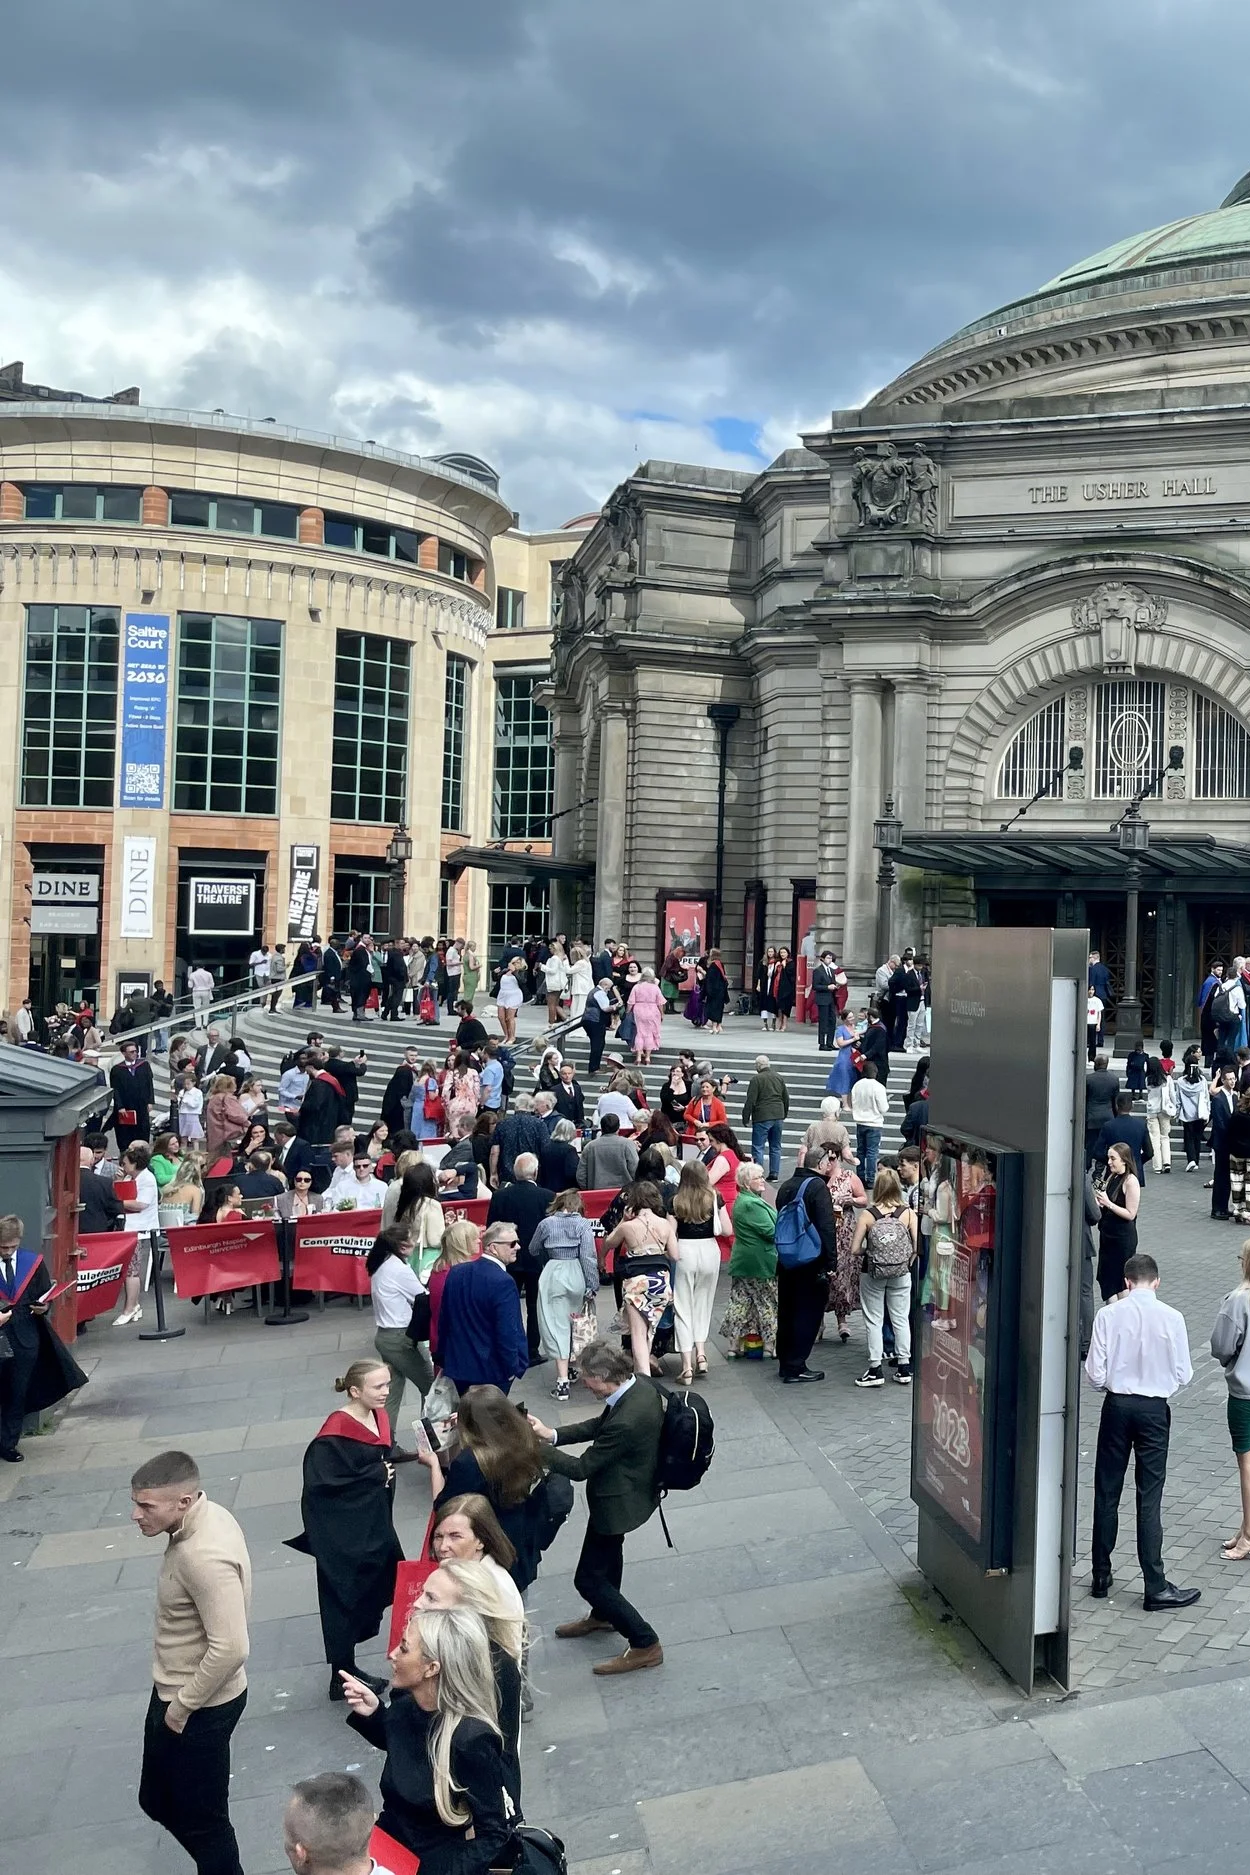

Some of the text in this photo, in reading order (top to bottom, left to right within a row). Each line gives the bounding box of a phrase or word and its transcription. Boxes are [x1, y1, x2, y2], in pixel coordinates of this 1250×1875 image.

[1028, 477, 1217, 504] THE USHER HALL
[128, 625, 167, 638] Saltire
[128, 637, 163, 649] Court
[127, 670, 166, 683] 2030
[38, 881, 91, 896] DINE
[129, 849, 149, 915] DINE
[197, 884, 248, 895] TRAVERSE
[197, 894, 242, 904] THEATRE
[288, 870, 311, 924] THEATRE
[300, 914, 316, 936] BAR
[183, 1238, 246, 1253] Edinburgh Napier
[209, 1243, 248, 1254] UNIVERSITY
[303, 1237, 376, 1247] Congratulatio
[332, 1247, 353, 1256] Class
[78, 1266, 120, 1281] ulations
[933, 1393, 971, 1468] 2023
